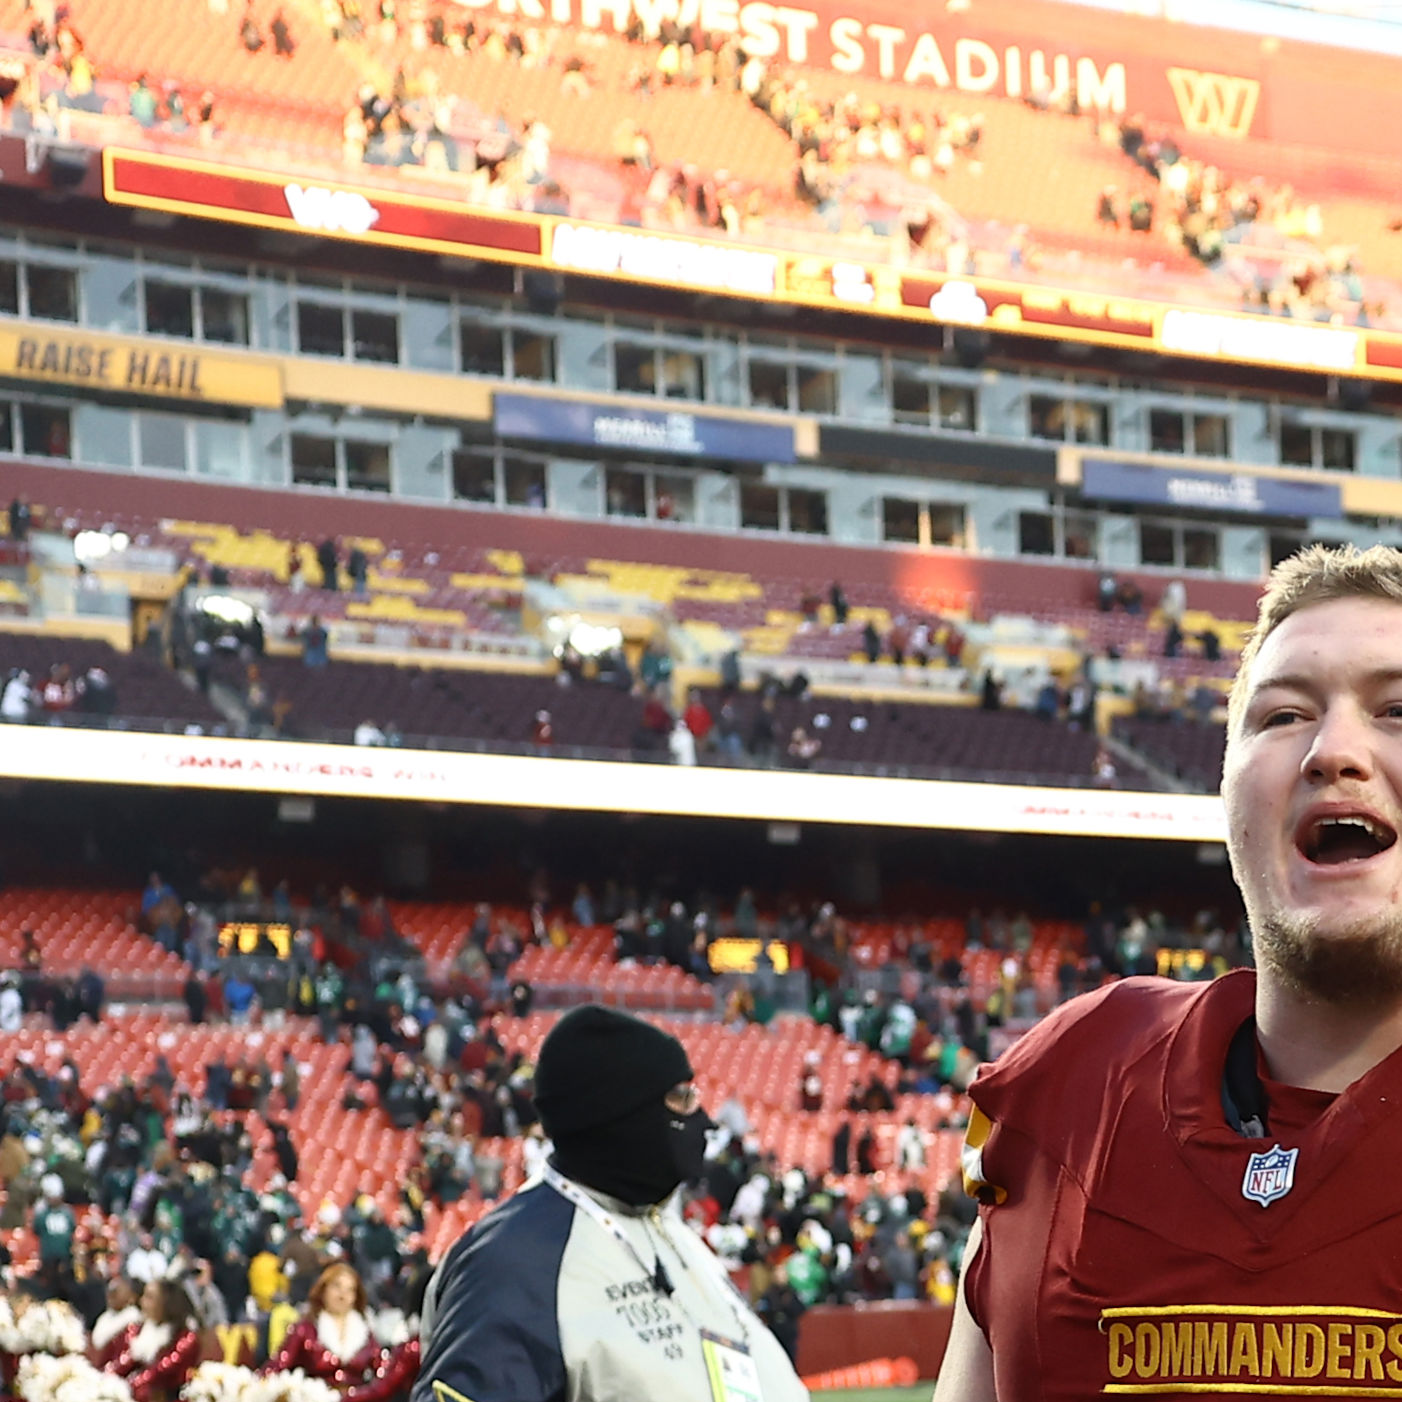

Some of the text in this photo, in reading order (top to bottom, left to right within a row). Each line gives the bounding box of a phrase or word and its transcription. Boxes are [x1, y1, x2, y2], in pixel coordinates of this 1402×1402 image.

[829, 17, 1127, 114] STADIUM
[17, 338, 203, 393] RAISE HAIL
[1250, 1169, 1282, 1194] NFL
